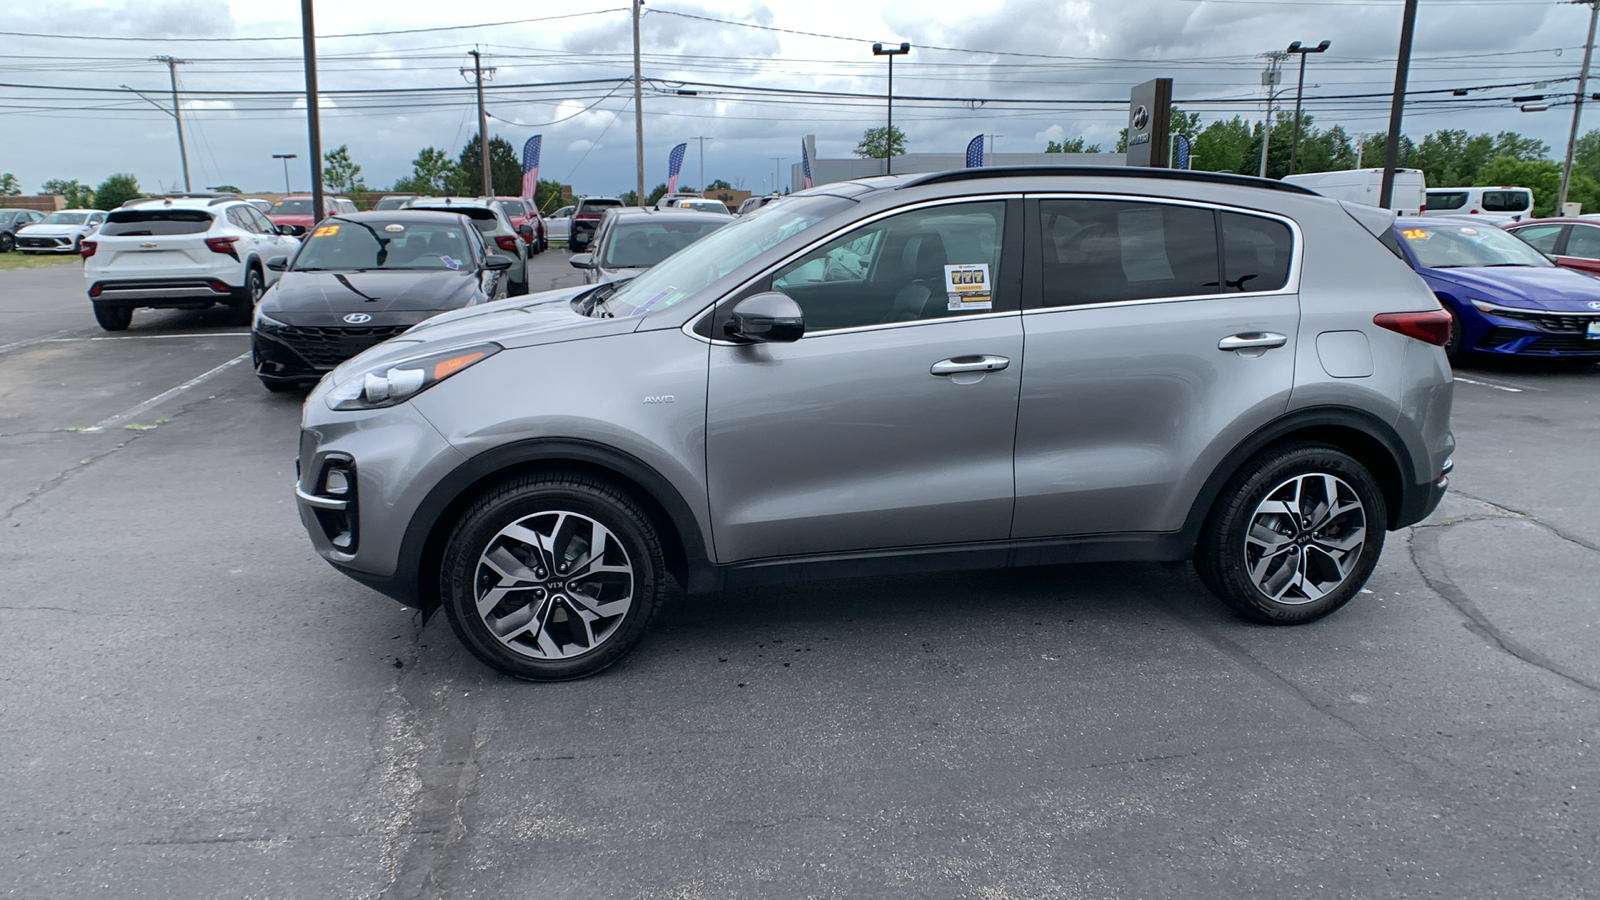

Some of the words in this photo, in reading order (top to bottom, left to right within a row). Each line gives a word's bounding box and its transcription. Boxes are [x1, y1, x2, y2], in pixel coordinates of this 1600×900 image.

[1402, 229, 1426, 240] 26
[643, 394, 675, 404] AWD
[1298, 535, 1310, 544] KIA
[546, 581, 563, 589] KIA
